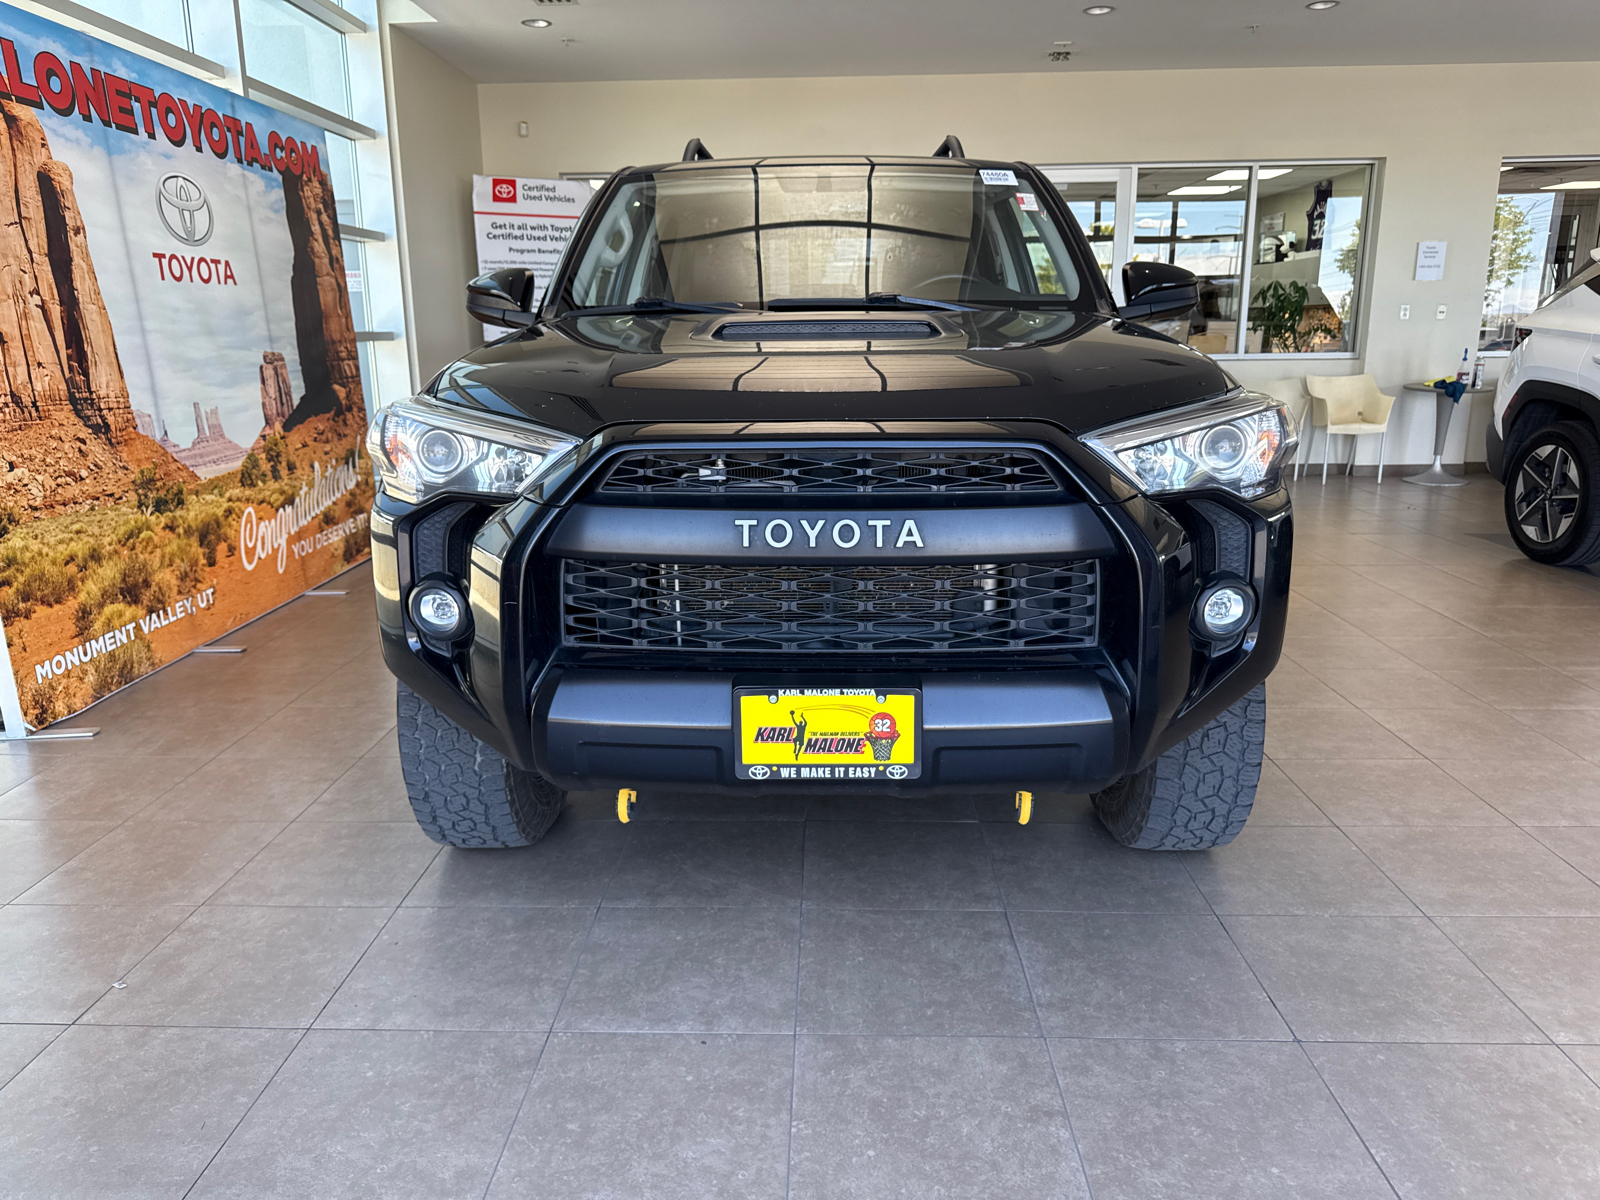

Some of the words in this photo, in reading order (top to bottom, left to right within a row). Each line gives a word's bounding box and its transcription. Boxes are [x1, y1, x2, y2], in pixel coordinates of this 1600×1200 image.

[0, 36, 322, 182] LONETOYOTA.COM
[522, 184, 556, 193] Certified
[522, 193, 543, 201] Used
[544, 194, 576, 203] Vehicles
[491, 222, 507, 231] Get
[508, 222, 515, 231] it
[516, 222, 528, 231] all
[529, 223, 549, 232] with
[486, 232, 524, 241] Certified
[526, 233, 547, 242] Used
[508, 247, 537, 255] Program
[152, 251, 238, 286] TOYOTA
[240, 434, 361, 574] Congratulations!
[291, 536, 315, 559] YOU
[315, 517, 358, 549] DESERVE
[734, 519, 925, 549] TOYOTA
[34, 622, 136, 685] MONUMENT
[139, 596, 197, 635] VALLEY,
[197, 587, 215, 609] UT
[778, 688, 802, 697] KARL
[804, 688, 841, 697] MALONE
[842, 688, 877, 697] TOYOTA
[874, 718, 891, 732] 32
[754, 726, 795, 743] KARL
[803, 737, 867, 755] MALONE
[780, 767, 797, 778] WE
[801, 767, 831, 778] MAKE
[835, 767, 845, 778] IT
[849, 767, 877, 778] EASY
